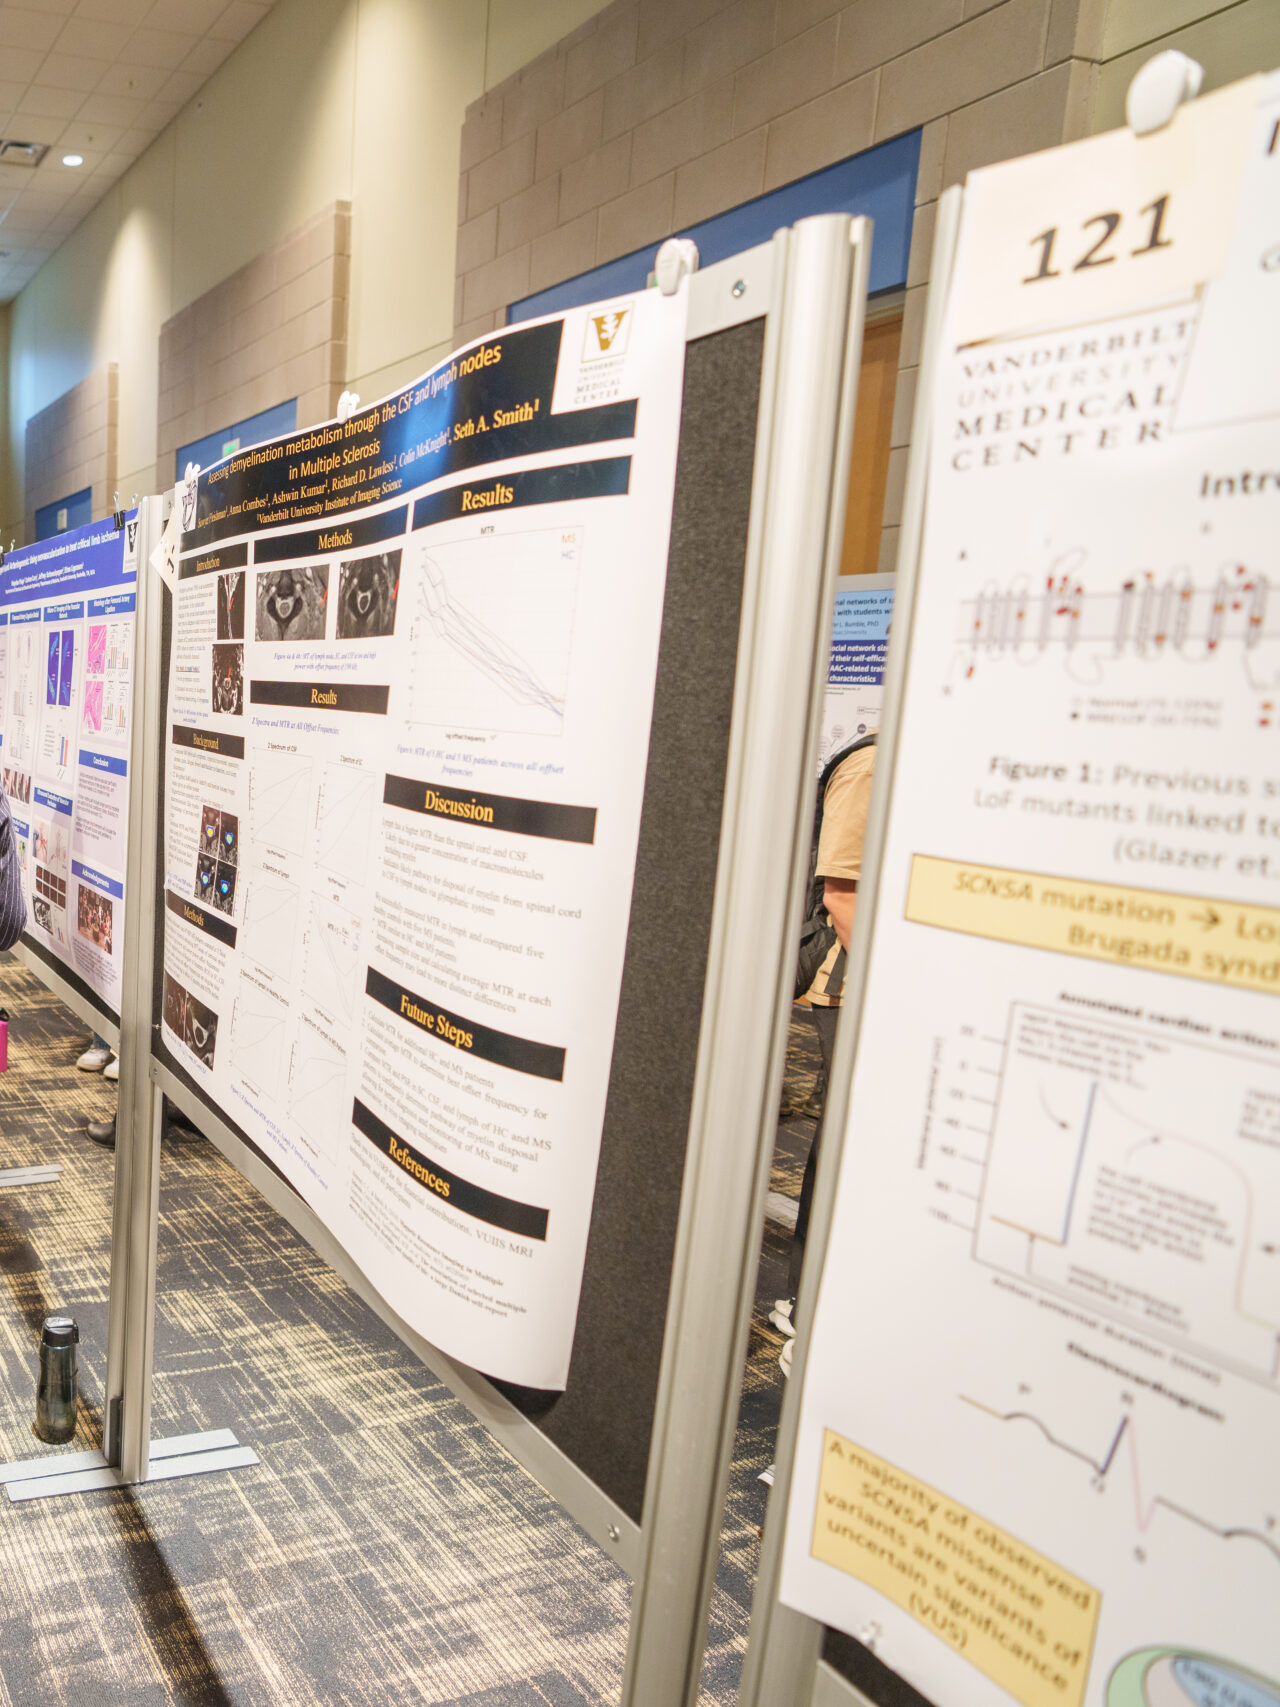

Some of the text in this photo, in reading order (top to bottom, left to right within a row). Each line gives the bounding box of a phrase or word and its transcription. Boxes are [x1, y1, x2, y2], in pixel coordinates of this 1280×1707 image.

[1021, 193, 1174, 285] 121
[962, 319, 1195, 379] VANDERBILT
[957, 353, 1186, 409] UNIVERSITY
[208, 345, 502, 485] Assessing demyelination metabolism through the CSF and lymph nodes
[954, 384, 1175, 441] MEDICAL
[272, 487, 299, 505] Ashwin
[332, 474, 358, 491] Richard
[399, 451, 415, 468] Colin
[453, 419, 475, 441] Seth
[476, 415, 490, 434] A.
[289, 438, 381, 481] in Multiple Sclerosis
[951, 419, 1164, 472] CENTER
[290, 500, 324, 518] University
[325, 494, 349, 512] Institute
[349, 492, 358, 505] of
[358, 486, 381, 506] Imaging
[382, 478, 402, 495] Science
[461, 483, 514, 511] Results
[1200, 470, 1280, 498] Intr
[318, 528, 353, 550] Methods
[196, 557, 221, 572] Introduction
[837, 607, 883, 616] with students
[846, 596, 888, 606] networks of
[835, 654, 851, 662] their
[847, 644, 876, 652] network
[829, 674, 876, 684] characteristics
[830, 664, 869, 673] AAC-related
[311, 688, 338, 705] Results
[192, 732, 219, 750] Background
[539, 763, 564, 775] offset
[988, 755, 1068, 785] Figure
[1113, 764, 1251, 798] Previous
[424, 789, 494, 824] Discussion
[1020, 795, 1136, 825] mutants
[1146, 801, 1245, 836] linked
[1113, 837, 1223, 871] (Glazer
[184, 904, 205, 927] Methods
[503, 893, 582, 920] from spinal cord
[1041, 887, 1176, 928] mutation
[526, 944, 545, 960] five
[1067, 923, 1192, 971] Brugada
[491, 982, 552, 1008] MTR at each
[399, 994, 474, 1048] Future Steps
[484, 1091, 549, 1121] frequency for
[498, 1142, 539, 1163] disposal
[511, 1131, 530, 1145] and
[532, 1136, 553, 1151] MS
[388, 1135, 451, 1197] References
[492, 1154, 519, 1174] using
[508, 1241, 535, 1258] MRI
[828, 1439, 1093, 1612] A majority of observed
[823, 1490, 1082, 1669] variants are variants of
[935, 1531, 1045, 1612] missense
[827, 1518, 929, 1588] uncertain
[933, 1581, 1070, 1693] significance
[908, 1592, 970, 1651] (VUS)
